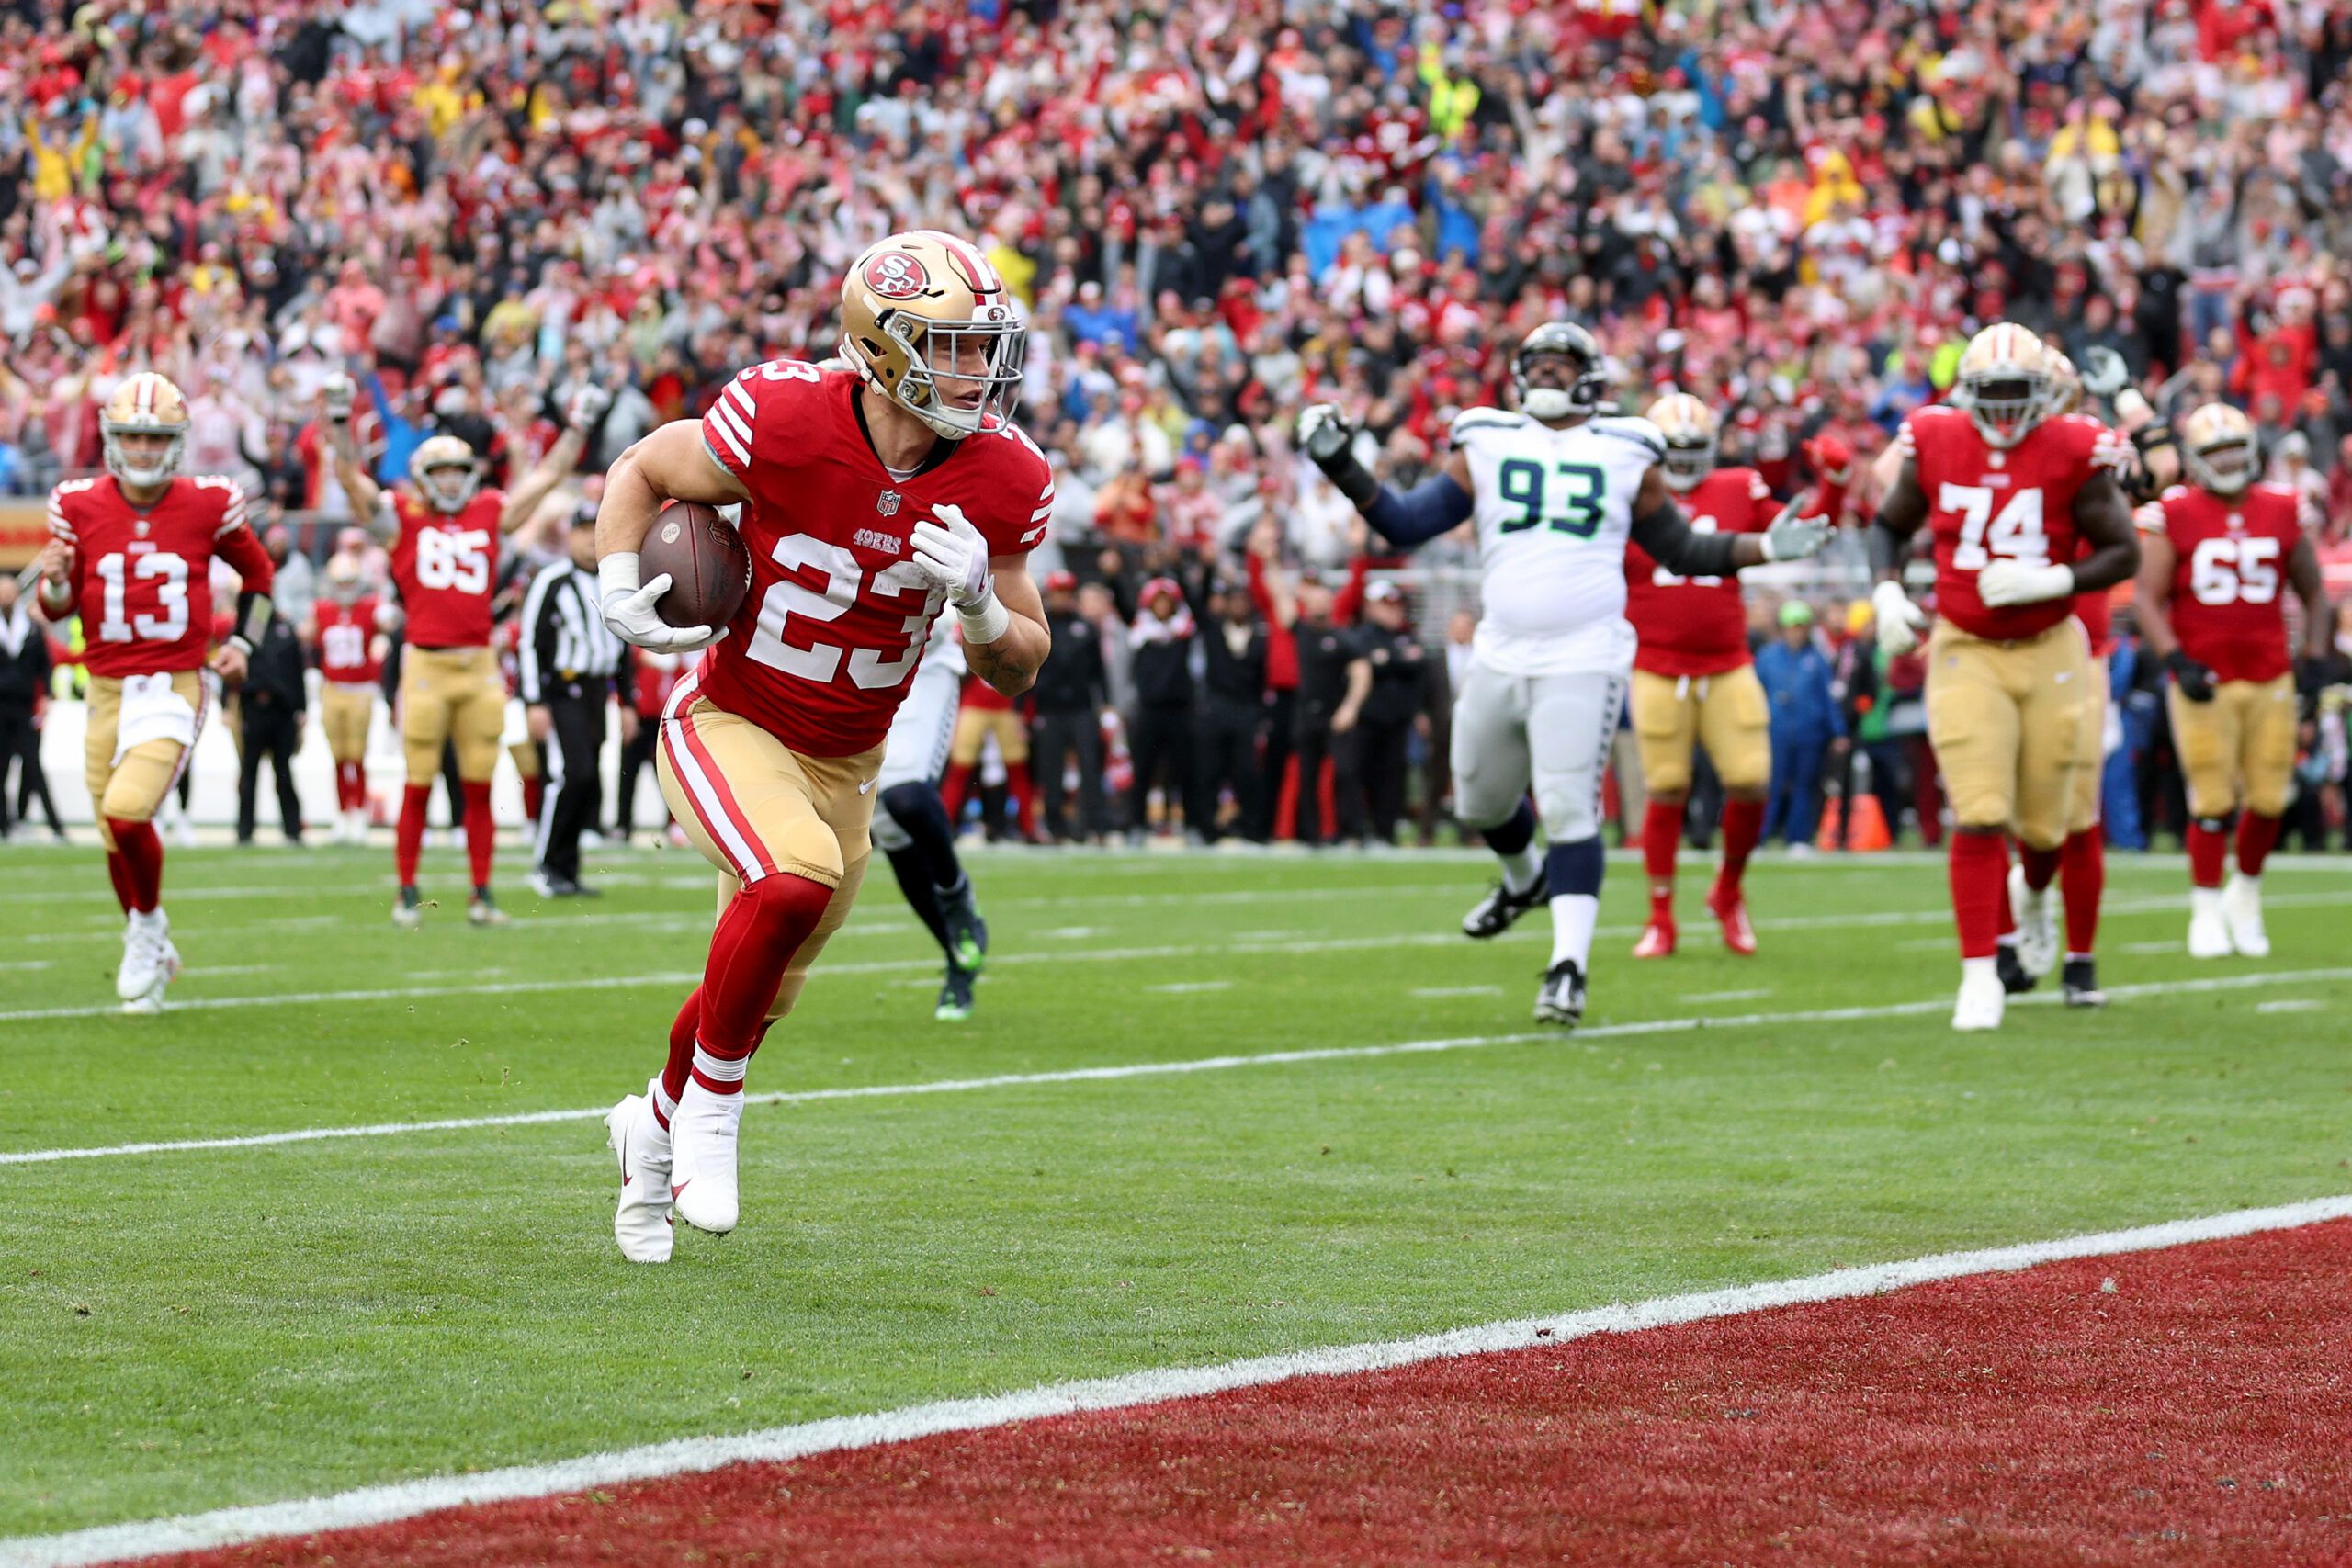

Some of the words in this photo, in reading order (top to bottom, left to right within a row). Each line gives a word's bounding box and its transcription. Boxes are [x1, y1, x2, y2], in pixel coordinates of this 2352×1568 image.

[1499, 457, 1606, 540] 93
[1939, 482, 2052, 569] 74
[416, 526, 490, 595] 85
[853, 528, 902, 556] 49ERS
[2190, 536, 2281, 605] 65
[96, 552, 189, 643] 13
[745, 532, 947, 689] 23
